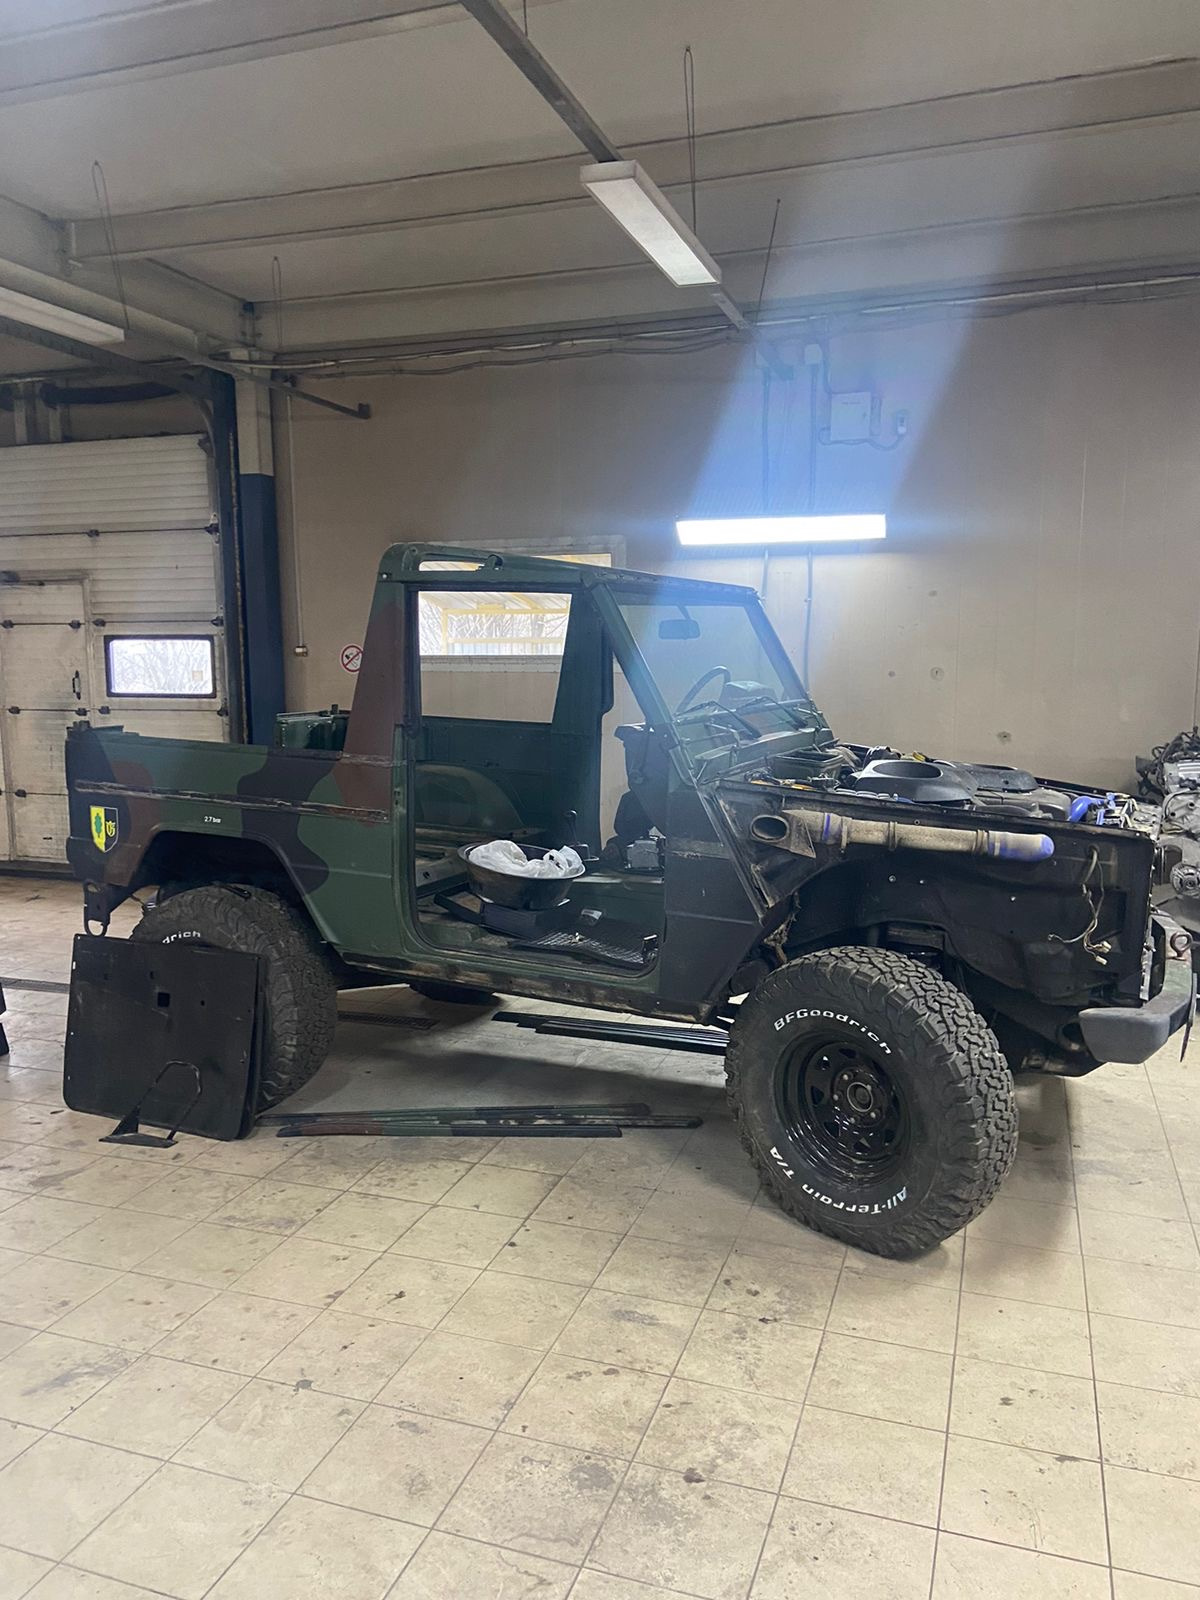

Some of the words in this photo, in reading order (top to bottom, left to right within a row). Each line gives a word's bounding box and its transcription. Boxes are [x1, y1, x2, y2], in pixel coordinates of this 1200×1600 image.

[773, 1008, 891, 1054] BFGoodrich
[769, 1146, 794, 1179] T/A
[802, 1184, 907, 1214] All-Terrain
